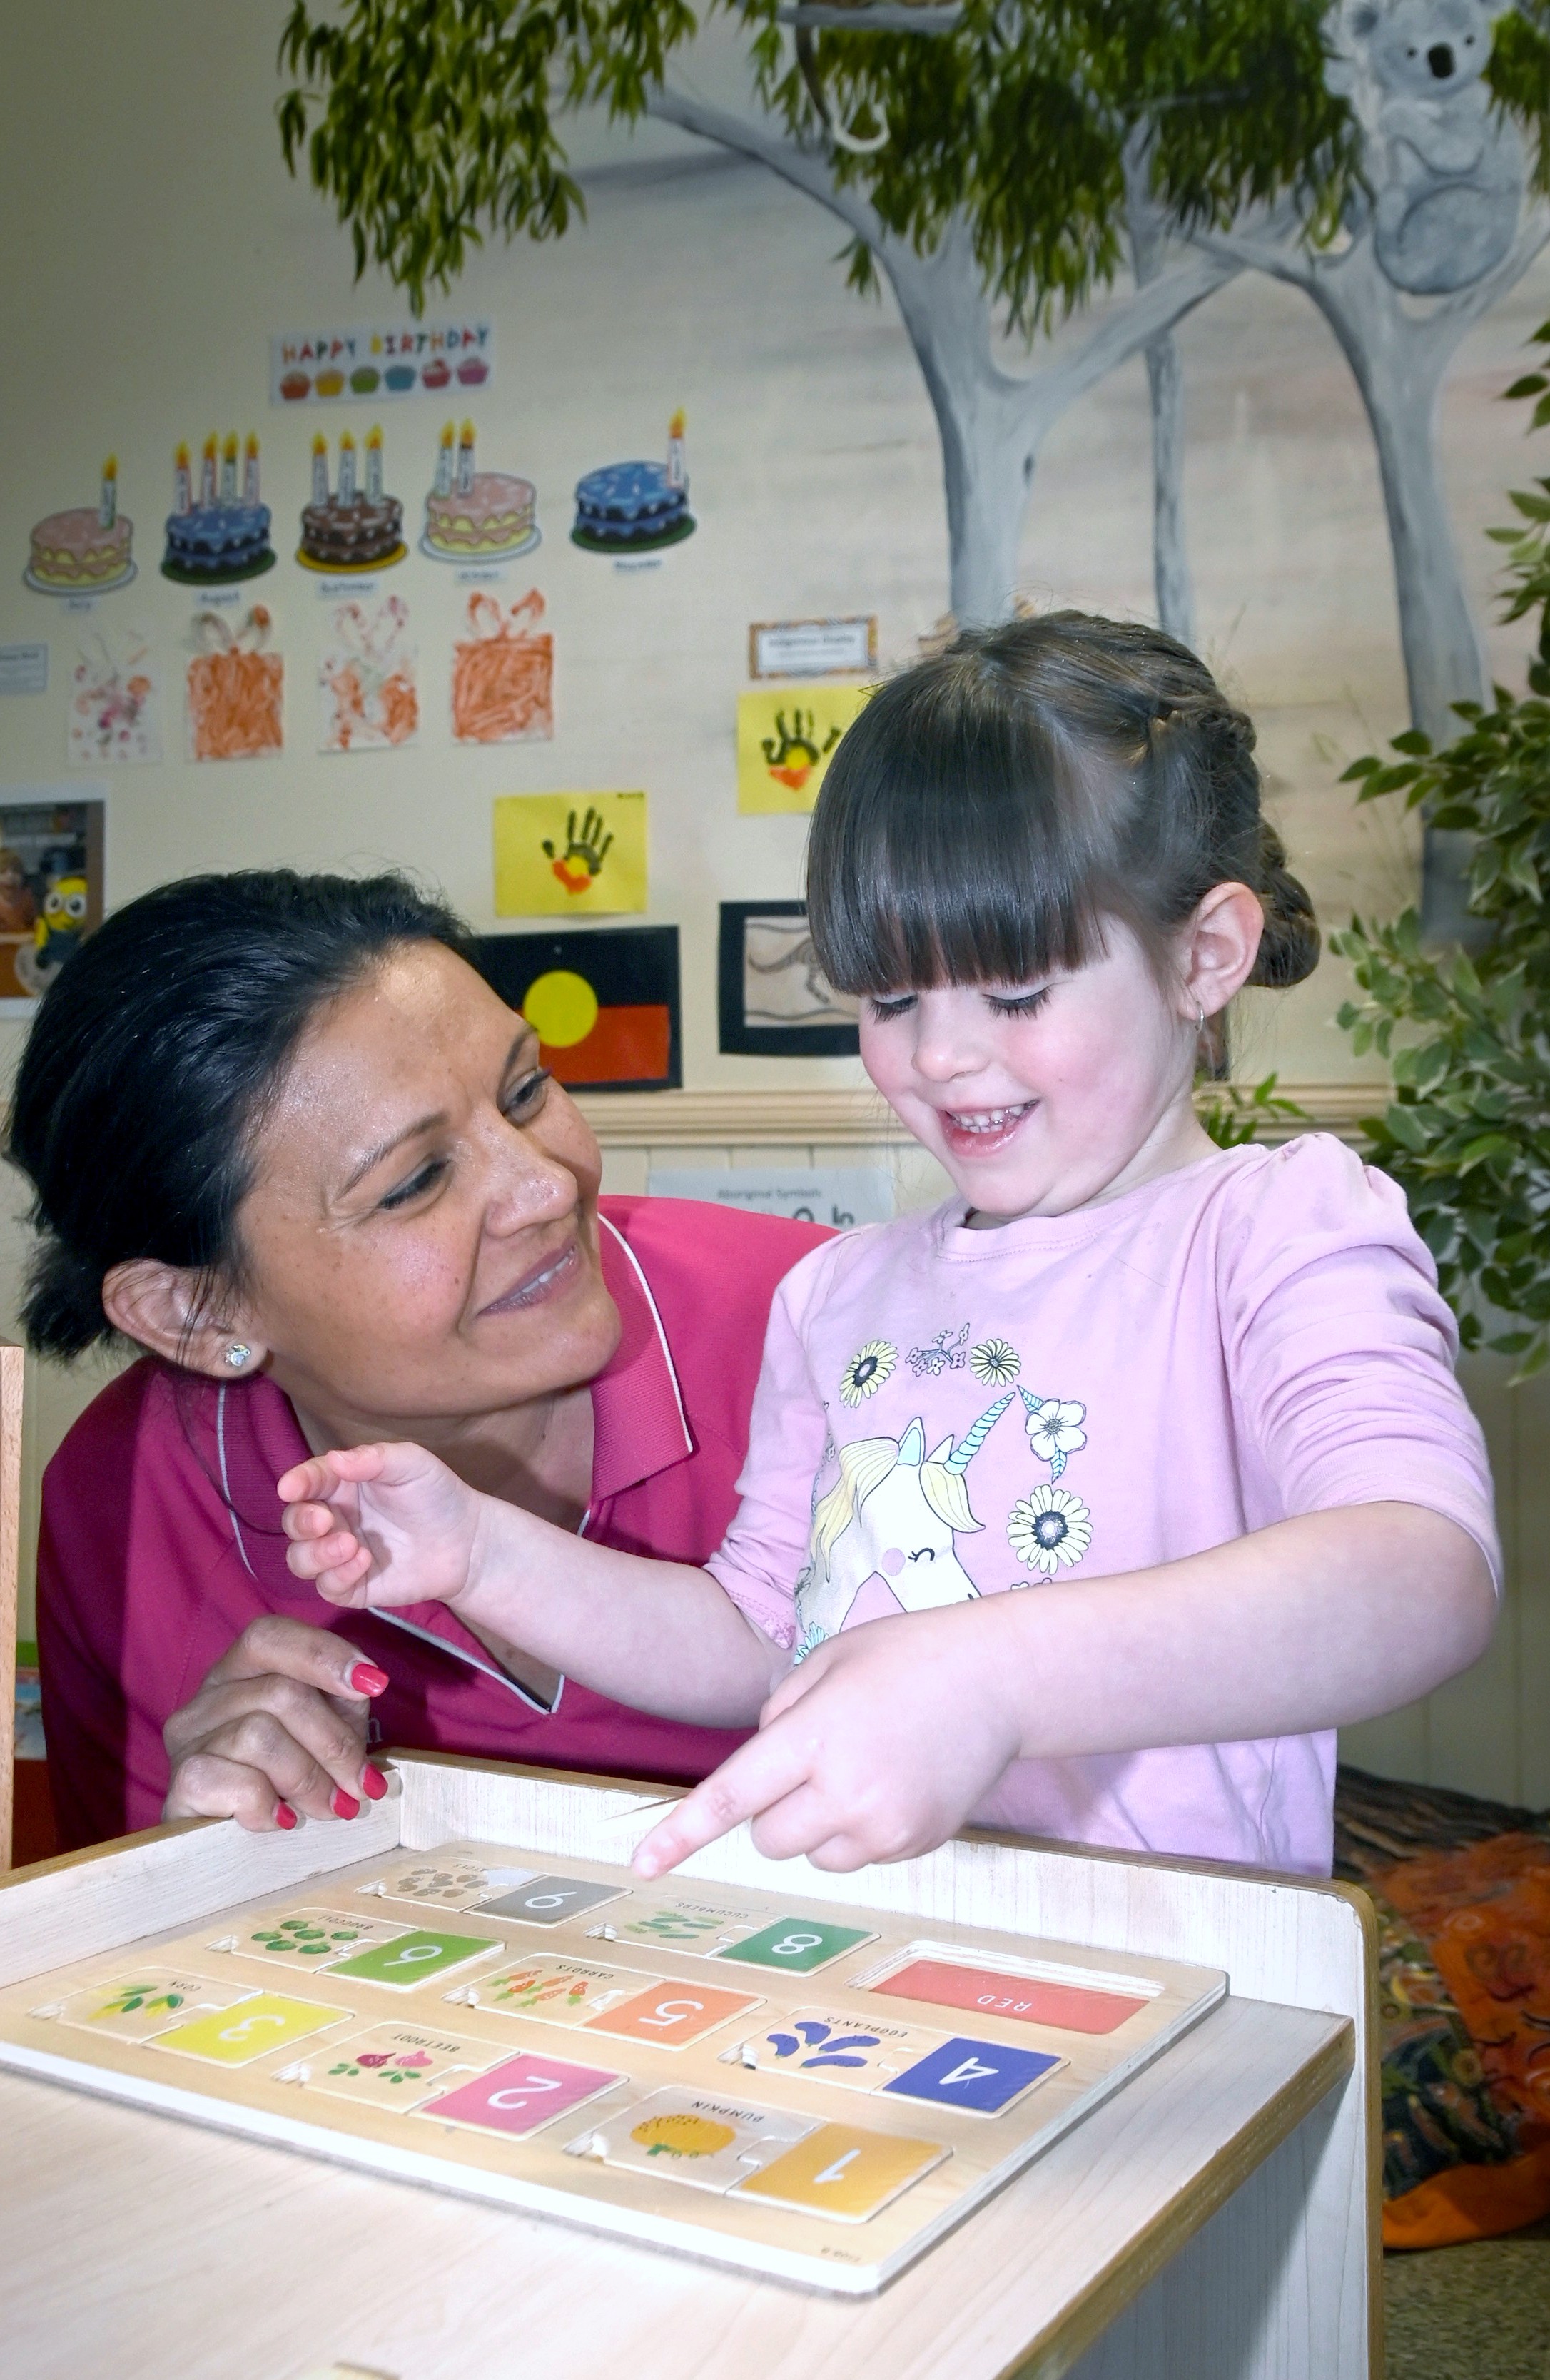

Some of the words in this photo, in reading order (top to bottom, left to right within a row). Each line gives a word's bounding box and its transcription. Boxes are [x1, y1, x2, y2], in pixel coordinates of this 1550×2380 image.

[281, 336, 356, 366] HAPPY
[370, 326, 490, 356] BIRTHDAY
[318, 1915, 375, 1930] BROCCOLI
[675, 1903, 749, 1920] CUCUMBERS
[771, 1933, 824, 1955] 8
[383, 1945, 443, 1967] 6
[556, 1964, 614, 1980] CARROTS
[168, 1980, 202, 1992] CORN
[638, 2000, 704, 2027] 5
[976, 1995, 1033, 2012] RED
[218, 2014, 286, 2041] 3
[824, 2016, 908, 2038] EGGPLANTS
[392, 2034, 461, 2052] BEETROOT
[938, 2057, 1000, 2085] 4
[487, 2075, 563, 2110] 2
[692, 2100, 765, 2122] PUMPKIN
[813, 2148, 861, 2184] 1
